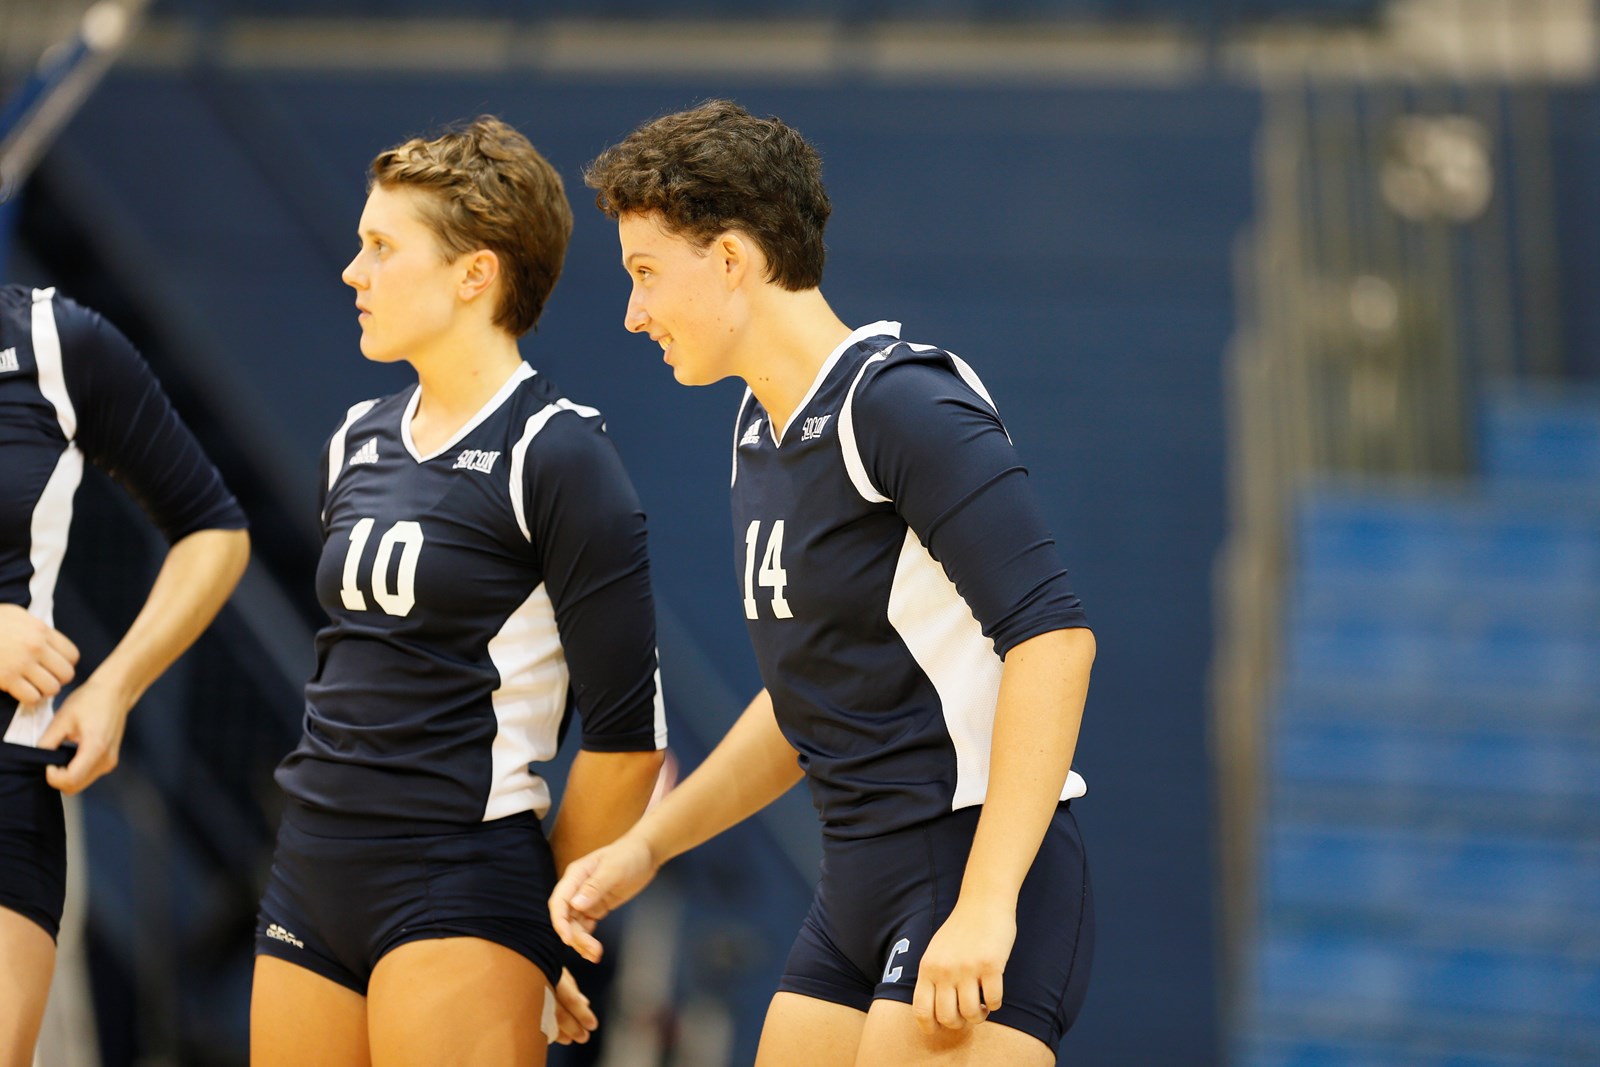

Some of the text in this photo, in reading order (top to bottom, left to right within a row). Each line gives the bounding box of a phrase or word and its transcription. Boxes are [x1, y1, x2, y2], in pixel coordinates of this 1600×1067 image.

[452, 449, 501, 474] SOCON
[340, 517, 424, 617] 10
[744, 519, 794, 620] 14
[881, 937, 910, 983] C
